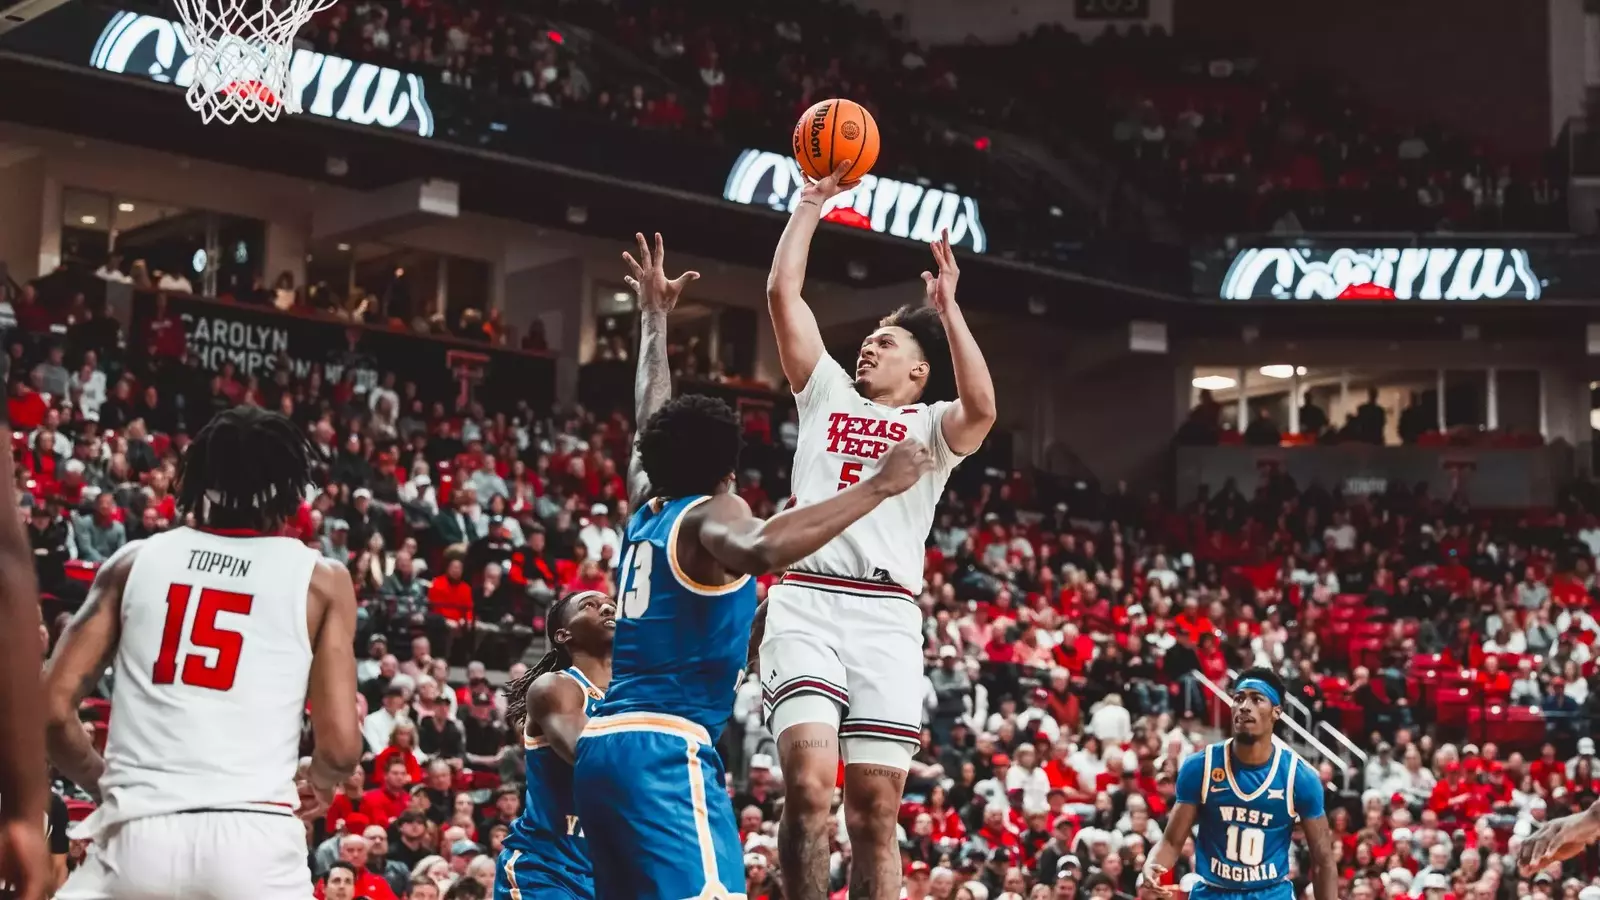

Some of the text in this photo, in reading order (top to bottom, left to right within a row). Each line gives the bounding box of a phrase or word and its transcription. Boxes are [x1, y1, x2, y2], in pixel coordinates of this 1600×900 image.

[811, 103, 832, 158] Wilson
[827, 412, 908, 442] TEXAS
[837, 461, 864, 492] 5
[187, 549, 251, 577] TOPPIN
[615, 540, 653, 619] 13
[152, 582, 254, 692] 15
[863, 767, 902, 780] SACRIFICE
[1219, 805, 1274, 827] WEST
[1225, 824, 1266, 866] 10
[1210, 857, 1278, 882] VIRGINIA
